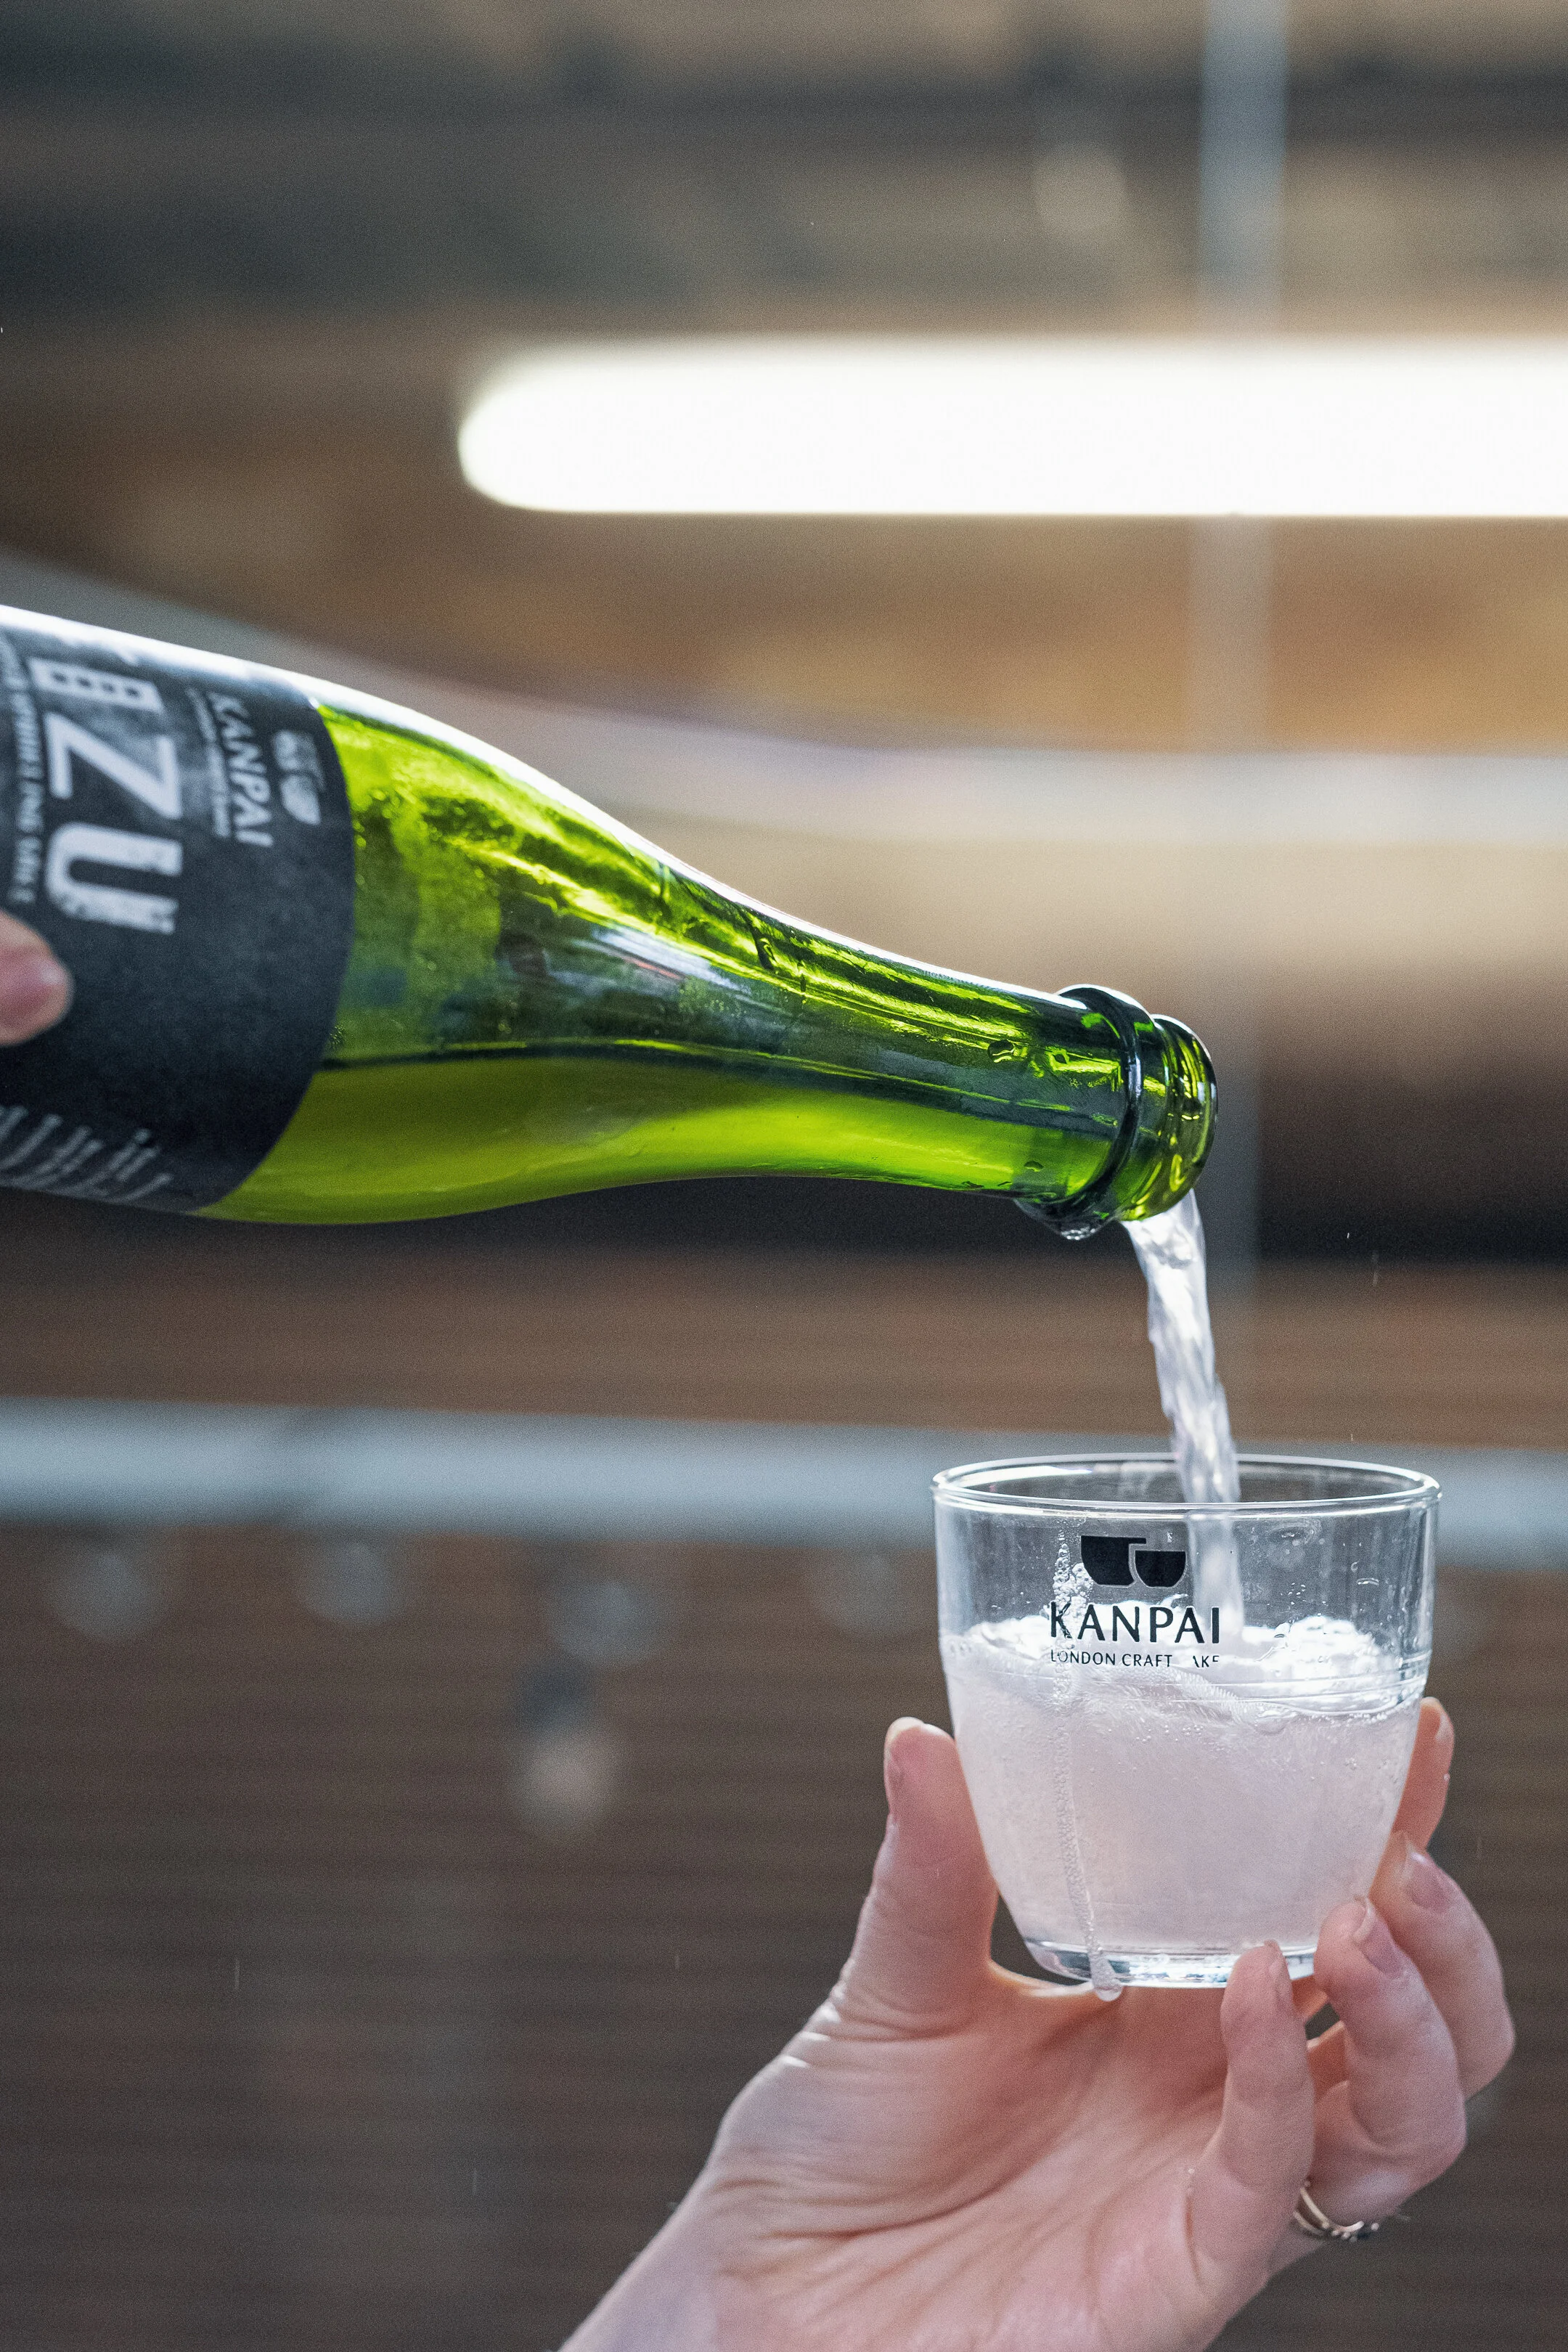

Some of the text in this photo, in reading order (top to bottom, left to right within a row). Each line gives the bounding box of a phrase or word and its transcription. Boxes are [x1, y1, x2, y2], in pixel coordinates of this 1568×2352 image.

[208, 691, 274, 848] KANPAI
[1050, 1601, 1220, 1644] KANPAI
[1050, 1649, 1116, 1666] LONDON
[1122, 1653, 1173, 1667] CRAFT
